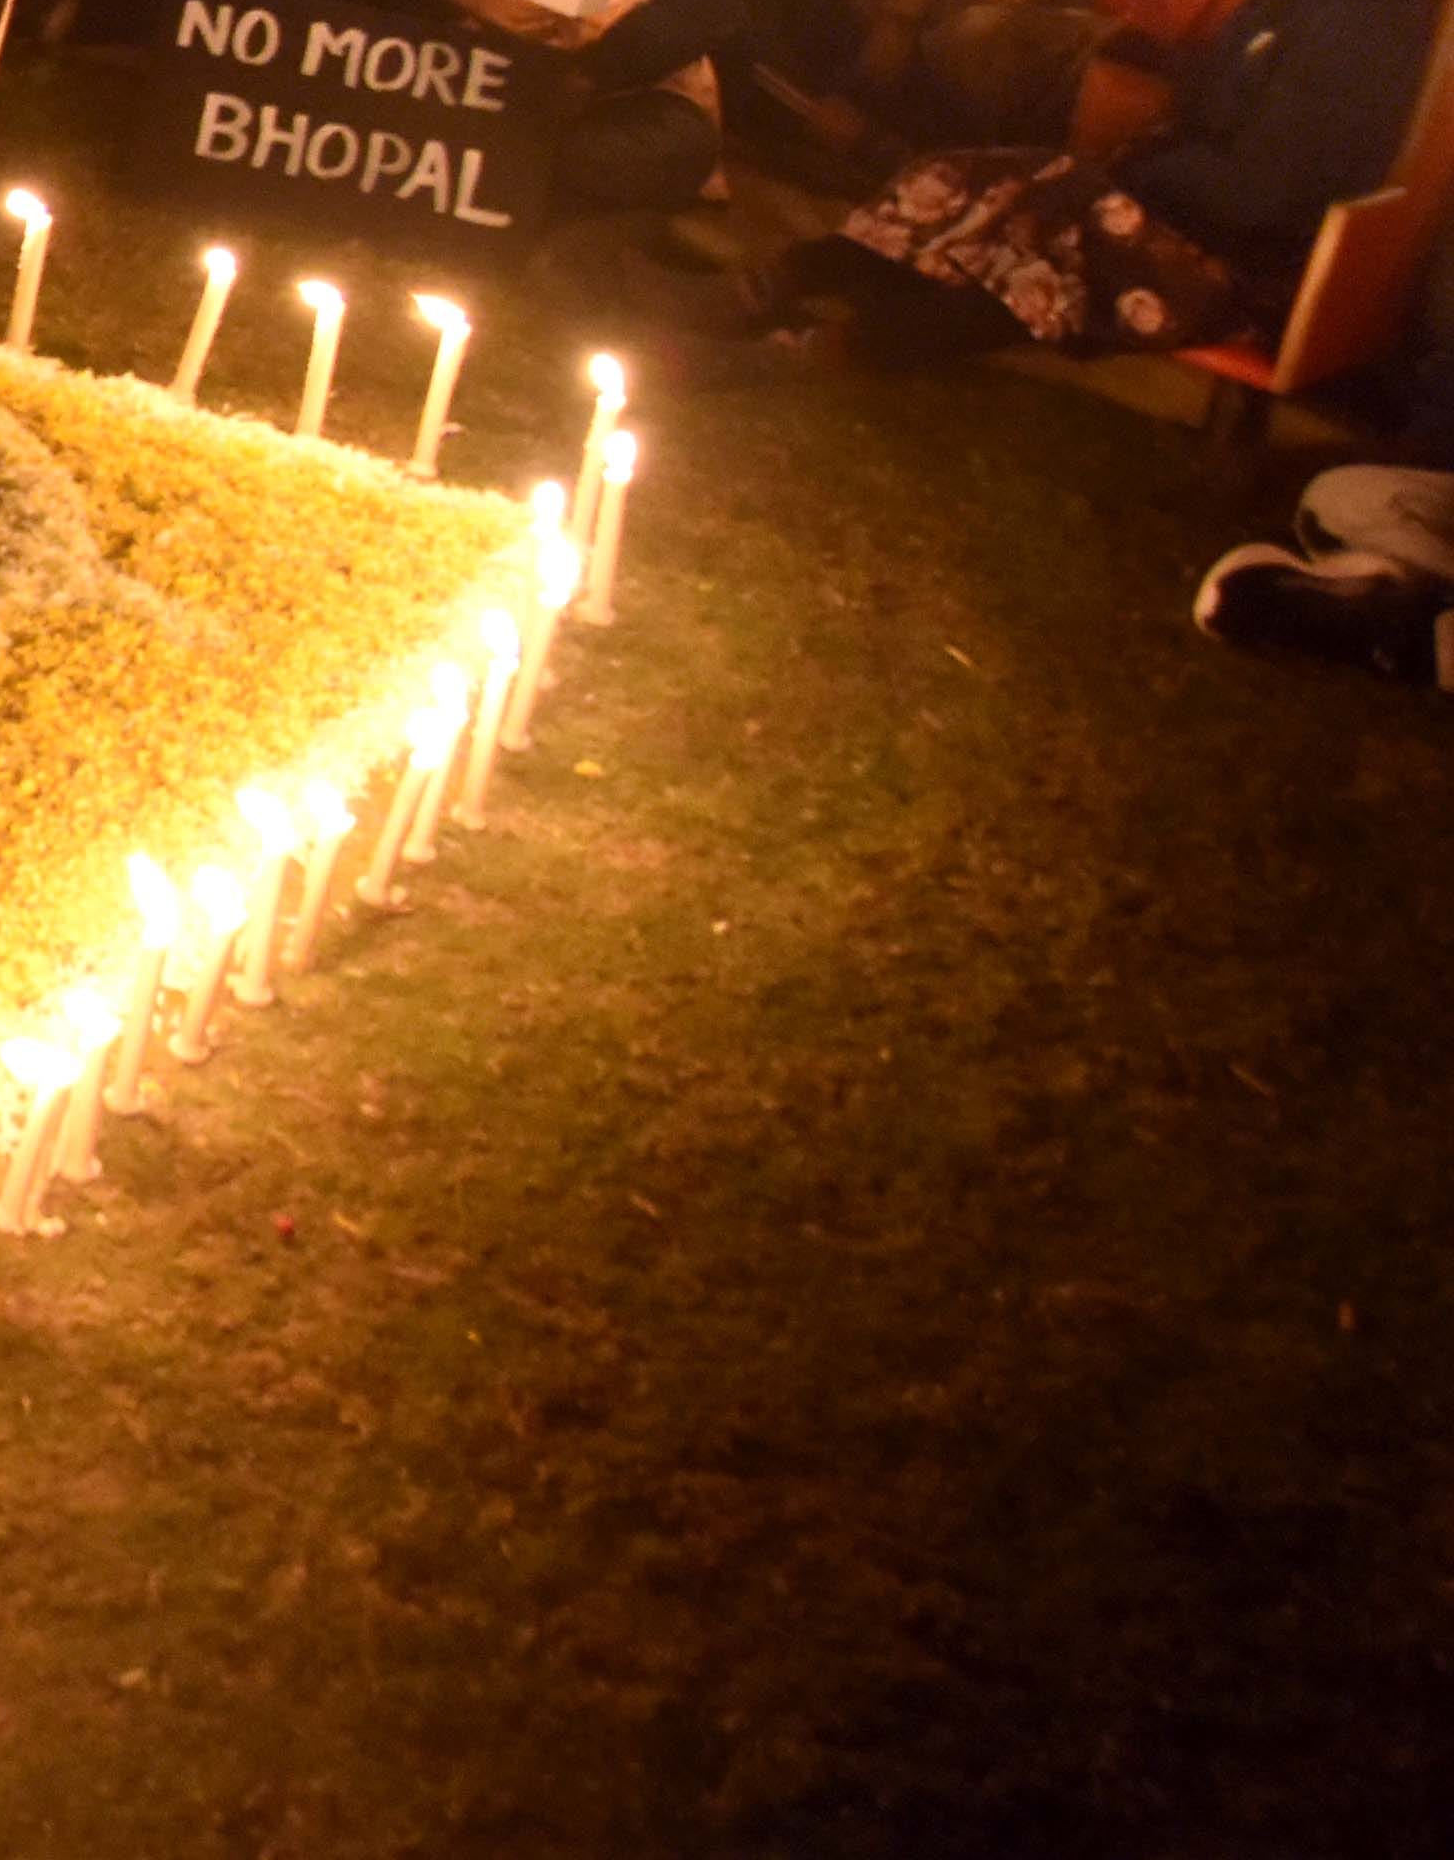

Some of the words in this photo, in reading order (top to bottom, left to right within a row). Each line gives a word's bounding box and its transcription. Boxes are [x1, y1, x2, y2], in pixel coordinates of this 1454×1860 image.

[177, 0, 283, 67] NO
[300, 20, 513, 112] MORE
[194, 91, 514, 229] BHOPAL
